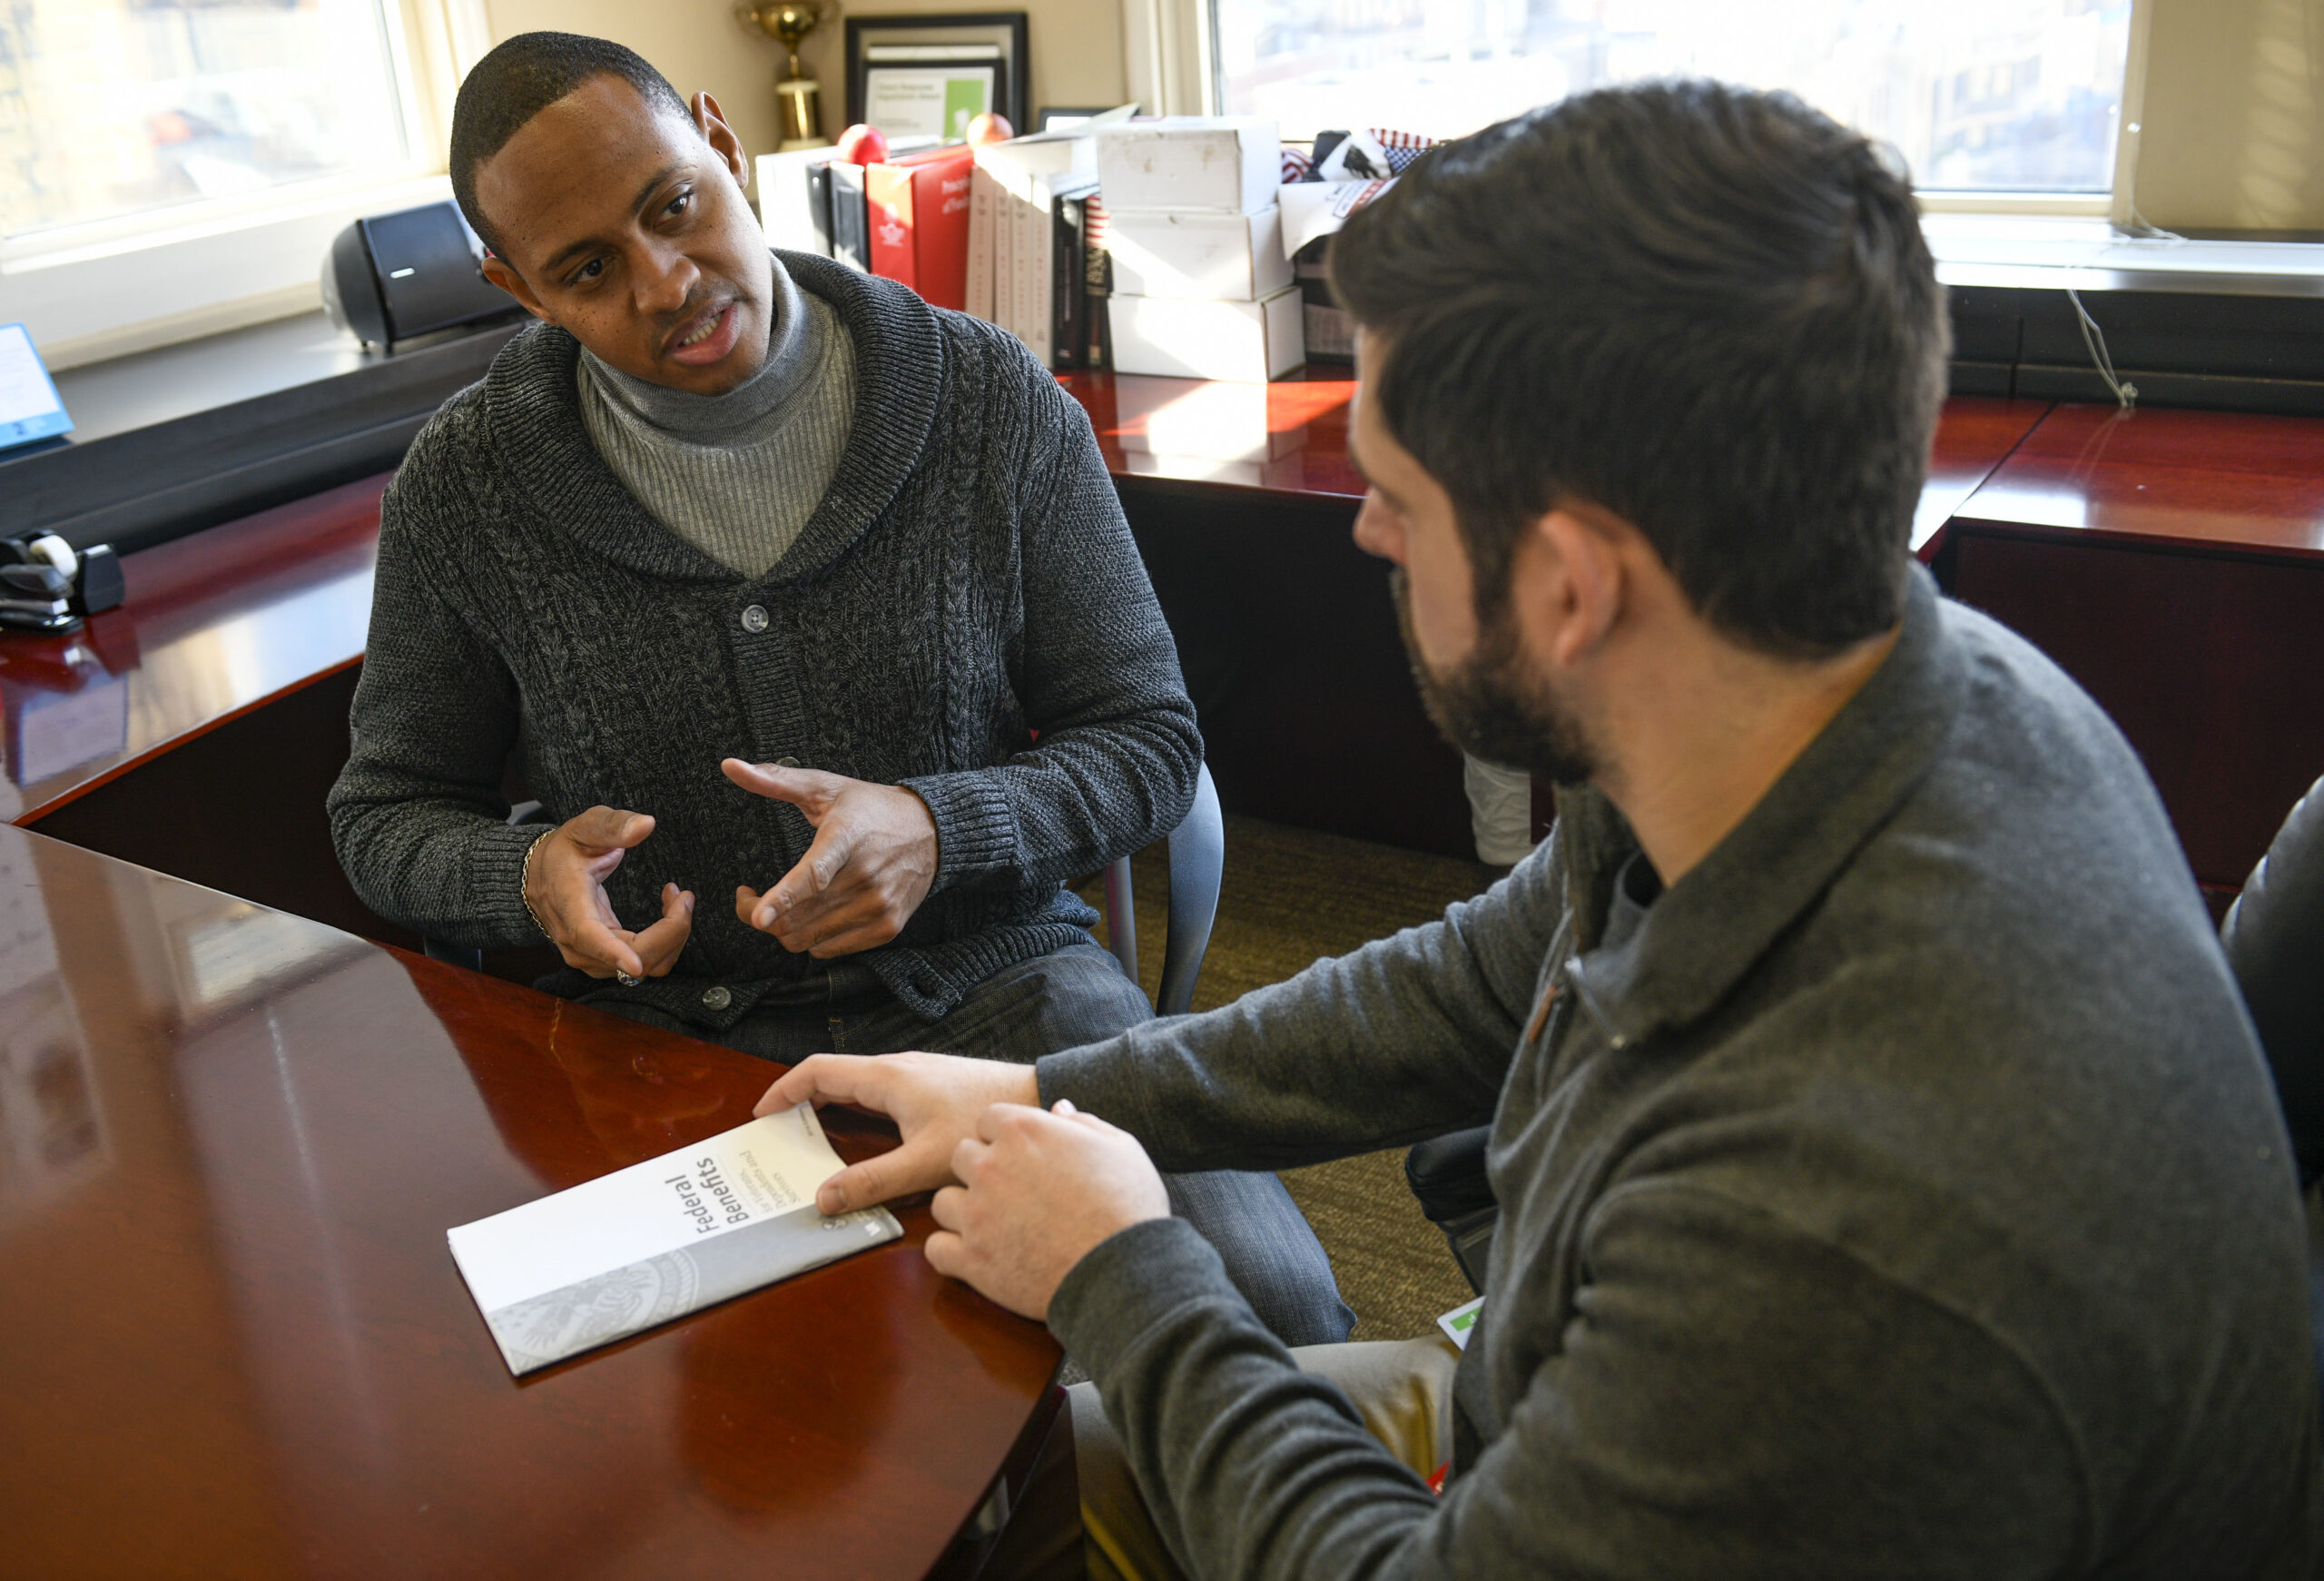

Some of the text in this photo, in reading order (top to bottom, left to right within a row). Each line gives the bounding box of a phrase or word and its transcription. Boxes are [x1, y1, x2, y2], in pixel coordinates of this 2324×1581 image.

[739, 1150, 757, 1168] and
[665, 1174, 720, 1233] Federal
[697, 1158, 750, 1224] Benefits
